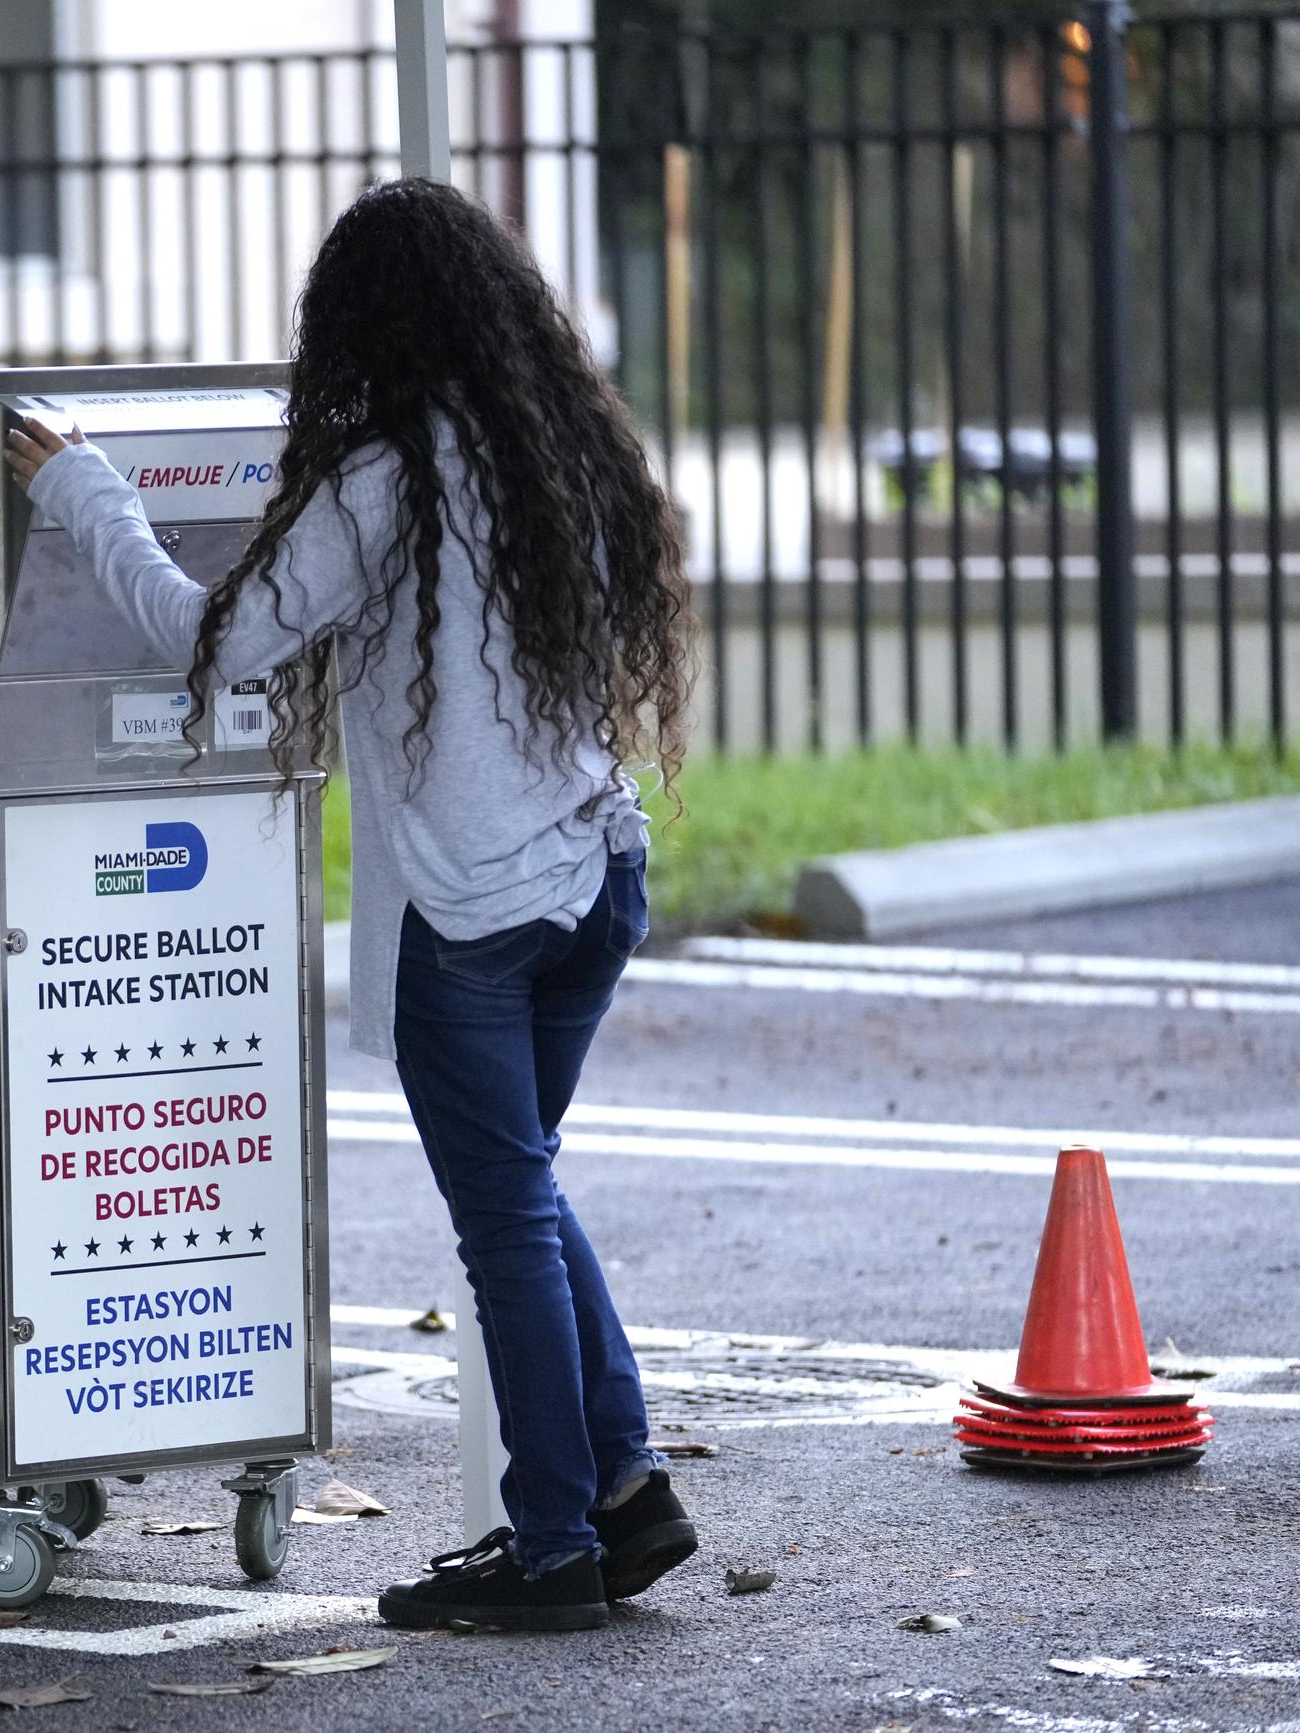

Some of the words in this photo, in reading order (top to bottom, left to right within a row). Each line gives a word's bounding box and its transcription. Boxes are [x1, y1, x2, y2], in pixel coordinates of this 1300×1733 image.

[76, 396, 131, 405] INSERT
[132, 394, 189, 403] BALLOT
[190, 392, 246, 402] BELOW
[138, 464, 224, 488] EMPUJE
[242, 463, 273, 483] PO
[240, 682, 257, 693] EV47
[123, 719, 157, 735] VBM
[97, 875, 143, 892] COUNTY
[42, 932, 148, 966] SECURE
[157, 924, 265, 958] BALLOT
[38, 977, 140, 1010] INTAKE
[149, 967, 268, 1003] STATION
[45, 1103, 145, 1137] PUNTO
[154, 1092, 267, 1128] SEGURO
[41, 1152, 76, 1181] DE
[86, 1139, 230, 1178] RECOGIDA
[238, 1135, 272, 1164] DE
[96, 1183, 221, 1221] BOLETAS
[86, 1285, 232, 1325] ESTASYON
[26, 1333, 190, 1376] RESEPSYON
[199, 1322, 292, 1358] BILTEN
[65, 1377, 126, 1415] VÒT
[133, 1369, 254, 1409] SEKIRIZE
